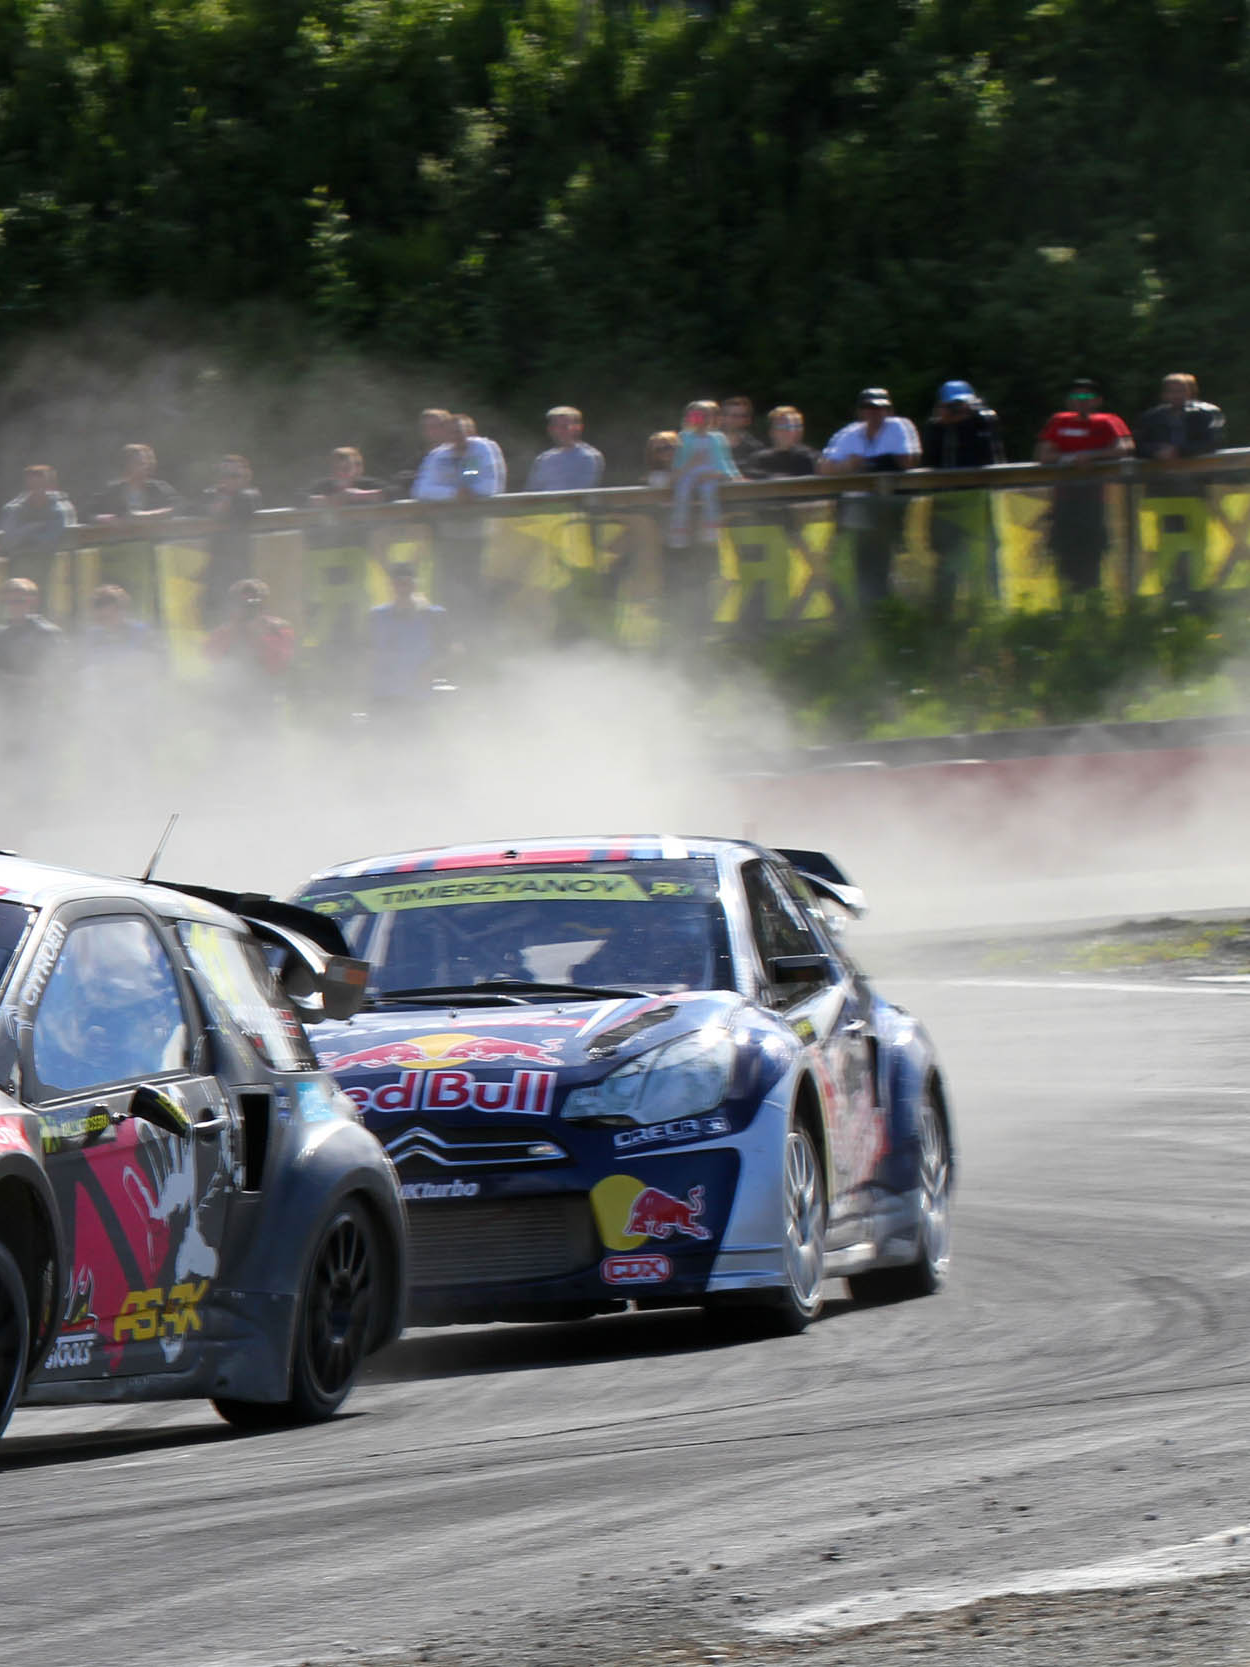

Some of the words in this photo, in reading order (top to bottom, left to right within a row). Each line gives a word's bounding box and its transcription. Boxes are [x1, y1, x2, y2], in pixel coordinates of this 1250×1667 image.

[380, 877, 628, 906] TIMERZYANOV
[341, 1070, 423, 1114] ed
[424, 1070, 558, 1115] Bull
